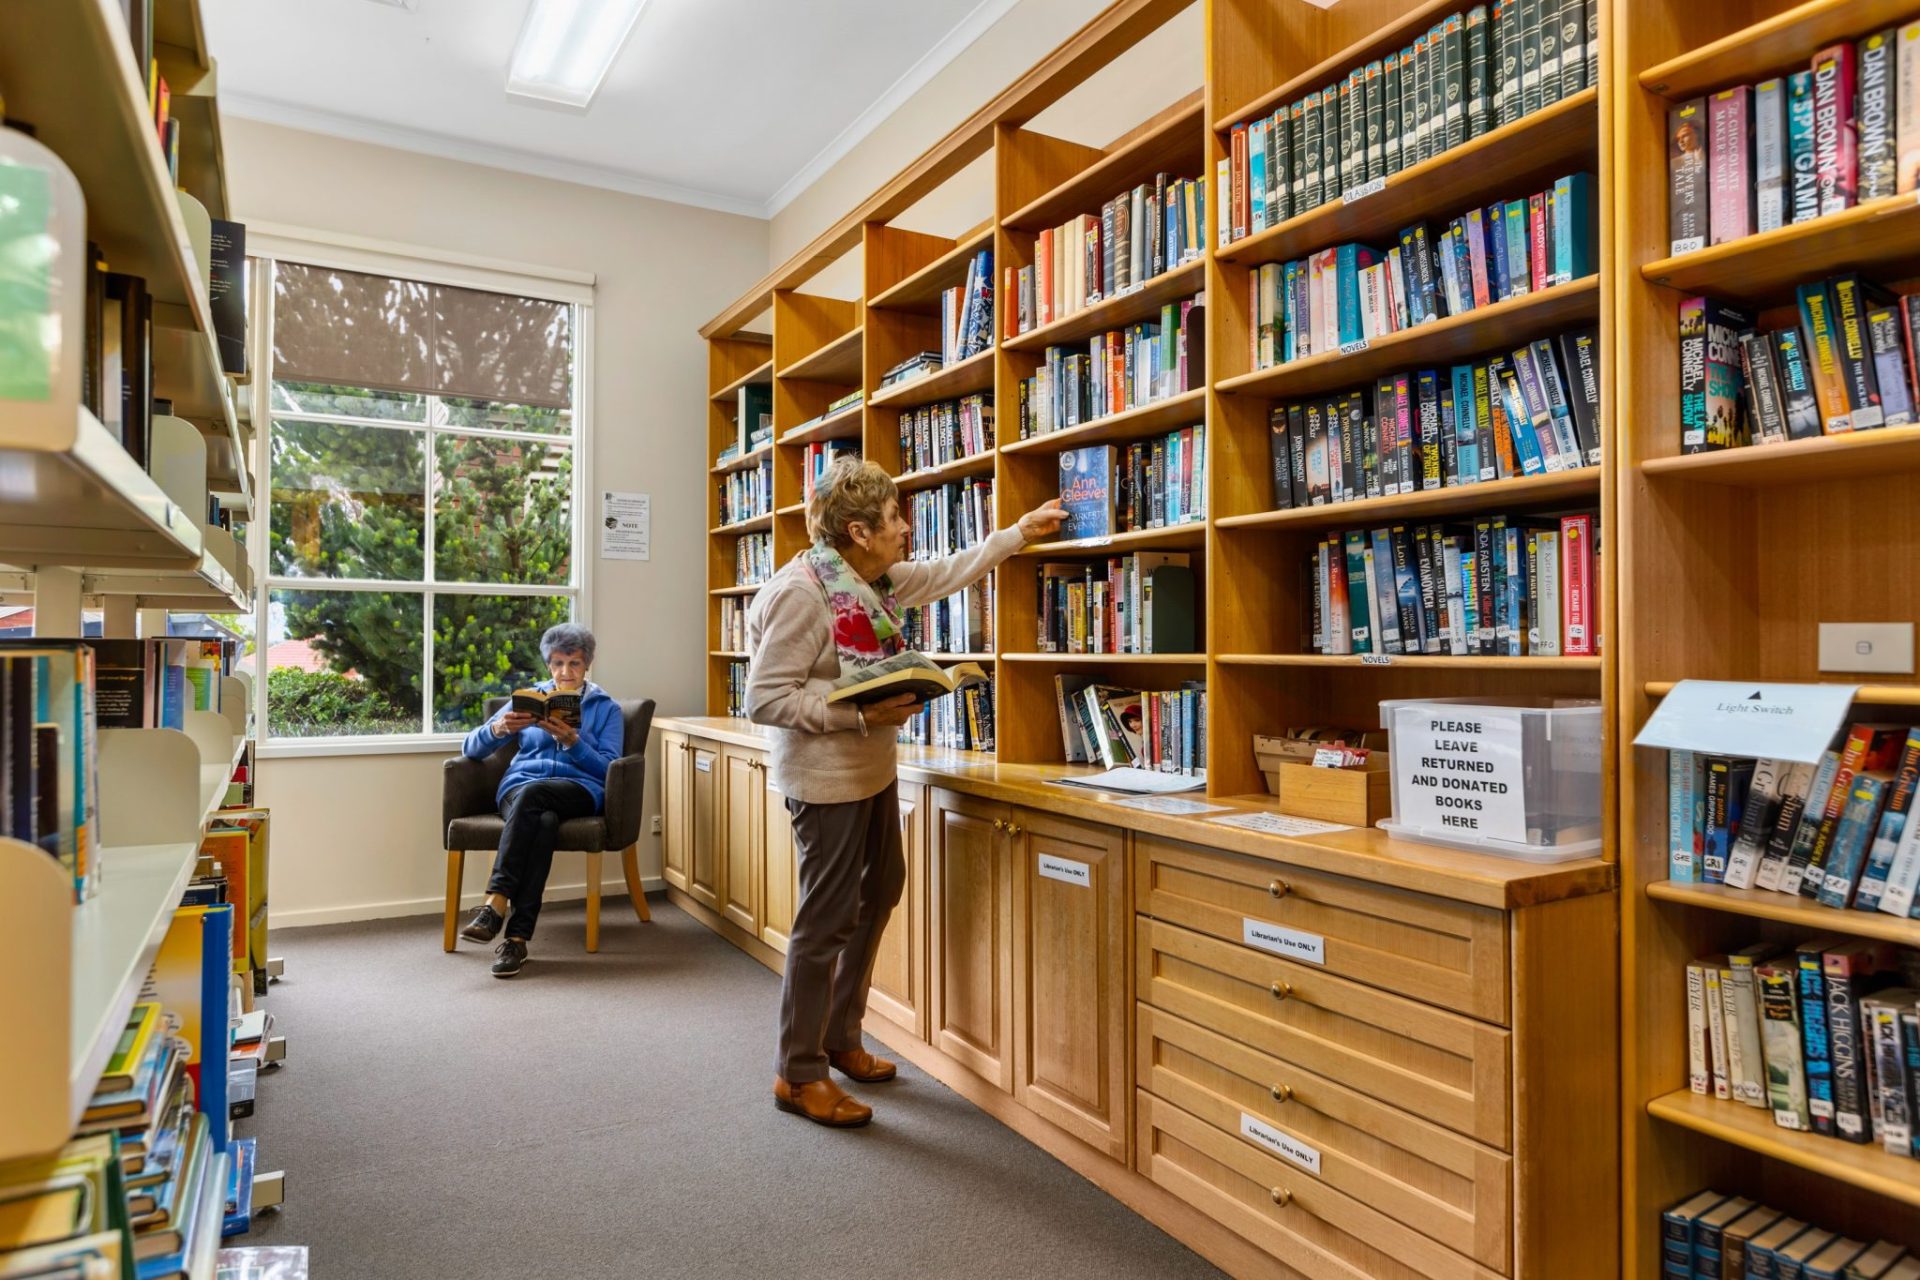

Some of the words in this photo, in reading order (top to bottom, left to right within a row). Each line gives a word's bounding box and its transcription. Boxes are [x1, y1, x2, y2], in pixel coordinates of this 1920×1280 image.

[1863, 46, 1886, 86] DAN
[1815, 68, 1836, 107] DAN
[1793, 99, 1814, 139] SPY
[1863, 86, 1886, 158] BROWN
[1714, 110, 1727, 160] MAKER'S
[1816, 105, 1838, 173] BROWN
[1727, 119, 1740, 193] CHOCOLATE
[1675, 167, 1685, 195] TALE
[1716, 160, 1727, 193] WIFE
[1537, 224, 1545, 249] BODY
[1836, 281, 1856, 319] ICHAEL
[1300, 309, 1308, 333] POINT
[1806, 294, 1826, 335] ICHAEL
[1816, 334, 1836, 376] CONNELLY
[1886, 317, 1898, 349] Michael
[1341, 341, 1366, 353] NOVELS
[1576, 336, 1590, 369] MCHAEL
[1843, 318, 1864, 360] CONNELLY
[1873, 320, 1888, 354] Connelly
[1682, 338, 1694, 391] CONNELLY
[1692, 337, 1704, 384] MICHAEL
[1791, 360, 1807, 391] CONNELLY
[1853, 361, 1862, 376] THE
[1459, 373, 1469, 398] MICHAEL
[1546, 376, 1561, 406] CONNELLY
[1582, 369, 1598, 404] CONNELLY
[1757, 367, 1771, 390] MICHAEL
[1856, 376, 1866, 397] BLACK
[1526, 382, 1542, 411] CONNELLY
[1682, 393, 1693, 425] SHOW
[1694, 392, 1704, 413] THE
[1760, 389, 1774, 414] CONNELLY
[1308, 407, 1316, 438] CNNOLLY
[1341, 416, 1350, 432] JOHN
[1397, 408, 1409, 438] CONNELLY
[1420, 402, 1431, 443] CONNELLY
[1429, 401, 1438, 437] MICHAEL
[1460, 400, 1471, 429] CONNELLY
[1477, 397, 1490, 428] CONNELLY
[1694, 413, 1704, 432] LAT
[1294, 435, 1303, 451] JOHN
[1343, 433, 1352, 464] CONNOLLY
[1381, 417, 1389, 454] CONNELLY
[1388, 417, 1396, 449] MICHAEL
[1423, 445, 1431, 456] OF
[1430, 443, 1439, 461] TWO
[1296, 451, 1304, 482] CONNOLLY
[1061, 487, 1107, 503] Cleeves
[1072, 475, 1097, 490] Ann
[1330, 556, 1338, 588] LaRose
[1396, 544, 1407, 572] Loop
[1480, 550, 1491, 592] FAIRSTEIN
[1420, 557, 1434, 609] EVANOVICH
[1437, 579, 1447, 609] SUTTON
[1462, 558, 1478, 612] FAGMENT
[1483, 595, 1492, 615] Killer
[1571, 589, 1579, 612] RICHARD
[1401, 608, 1409, 630] EVANS
[1408, 602, 1416, 633] NICHOLAS
[1362, 655, 1390, 664] NOVELS
[1715, 702, 1748, 714] Light
[1751, 703, 1794, 716] Switch
[1430, 720, 1482, 734] PLEASE
[1434, 739, 1479, 753] LEAVE
[1845, 734, 1866, 766] Jhn
[1421, 757, 1495, 774] RETURNED
[1411, 774, 1438, 787] AND
[1442, 777, 1509, 794] DONATED
[1671, 774, 1681, 814] SWIMMING
[1708, 771, 1717, 794] JAMES
[1717, 784, 1726, 796] the
[1824, 767, 1854, 819] Grisham
[1890, 766, 1918, 811] Grisham
[1435, 795, 1483, 811] BOOKS
[1715, 797, 1726, 824] pardon
[1808, 779, 1830, 819] Grisham
[1441, 814, 1479, 829] HERE
[1671, 814, 1681, 842] CIRCLE
[1706, 795, 1716, 835] GRIPPANDO
[1821, 819, 1833, 834] THE
[1251, 929, 1282, 944] Librarian's
[1284, 938, 1296, 947] Use
[1297, 942, 1316, 953] ONLY
[1689, 971, 1701, 1011] HEYER
[1826, 977, 1850, 1015] JACK
[1804, 999, 1829, 1058] HIGGINS
[1879, 1014, 1895, 1041] ACK
[1831, 1017, 1856, 1079] HIGGINS
[1249, 1125, 1281, 1147] Librarian's
[1282, 1142, 1294, 1154] Use
[1295, 1150, 1314, 1164] ONLY
